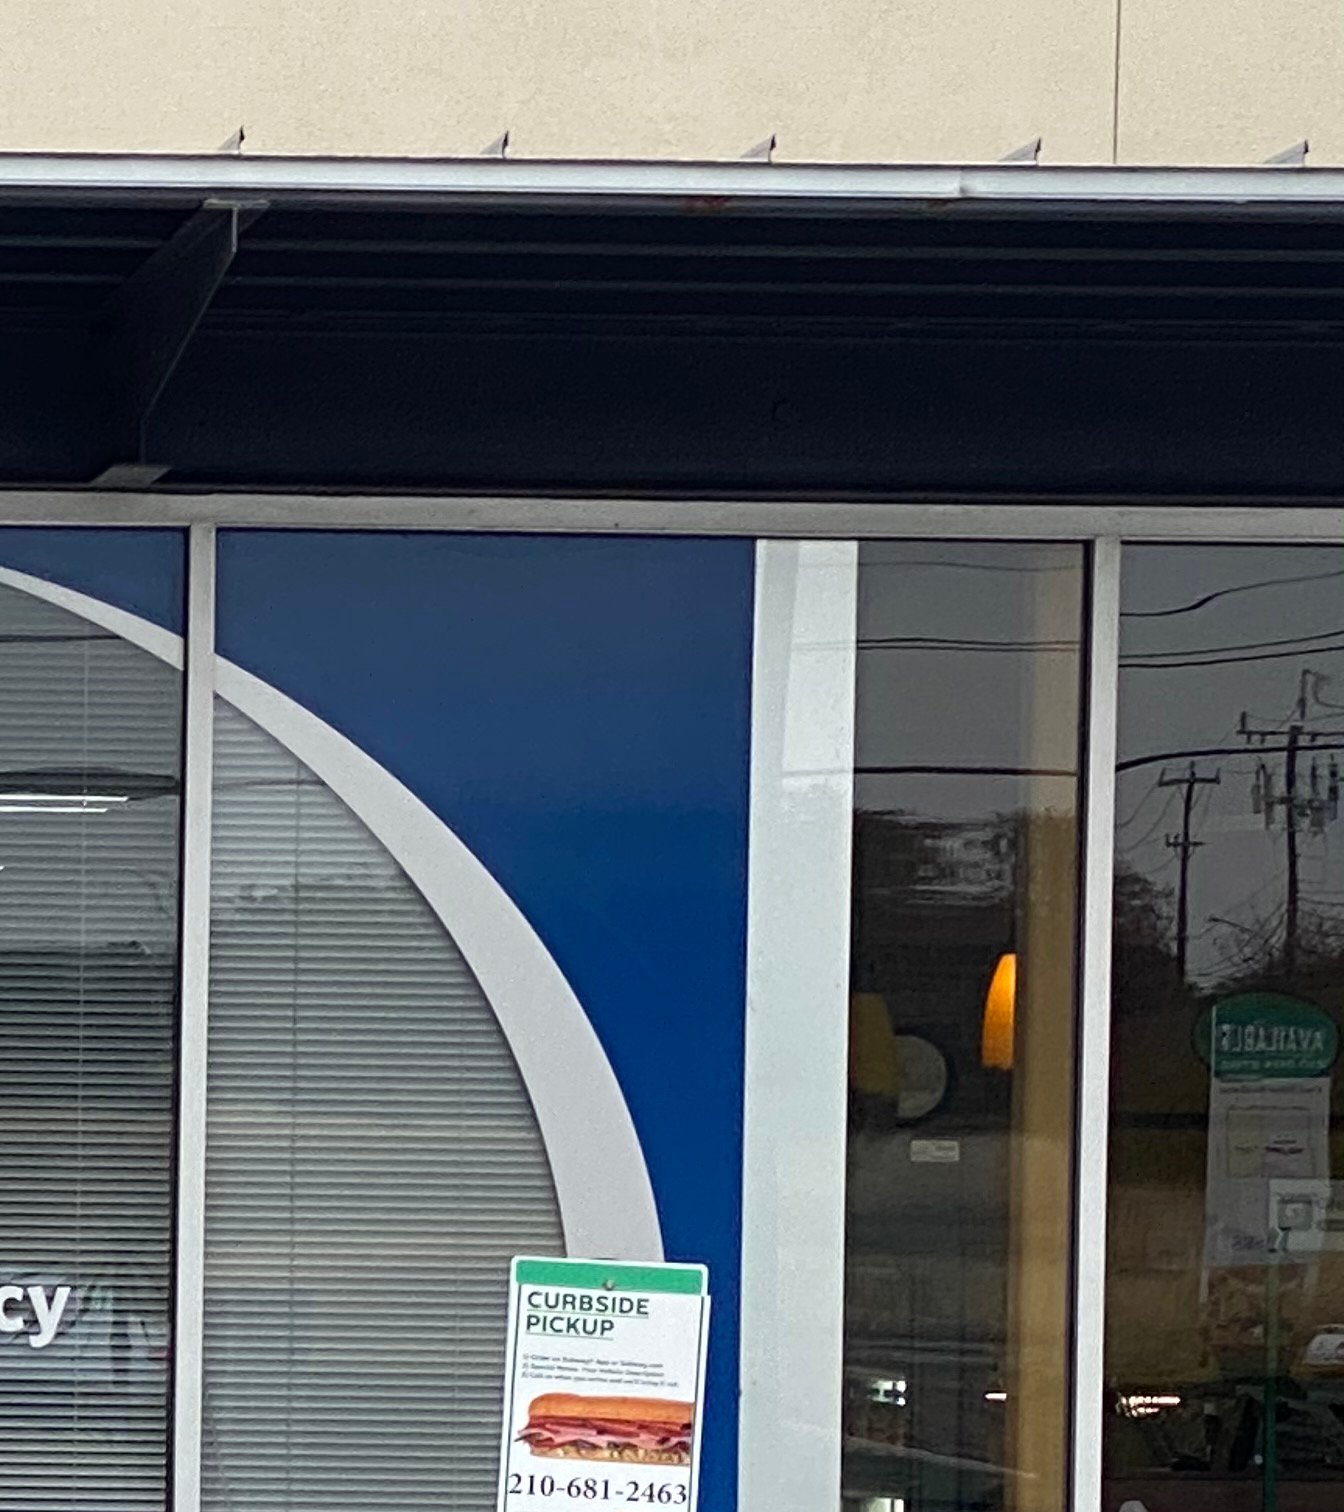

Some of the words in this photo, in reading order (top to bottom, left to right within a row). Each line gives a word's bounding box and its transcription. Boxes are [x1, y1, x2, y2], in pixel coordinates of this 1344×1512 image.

[526, 1291, 650, 1316] CURBSIDE
[525, 1314, 616, 1337] PICKUP
[508, 1472, 688, 1506] 210-681-2463
